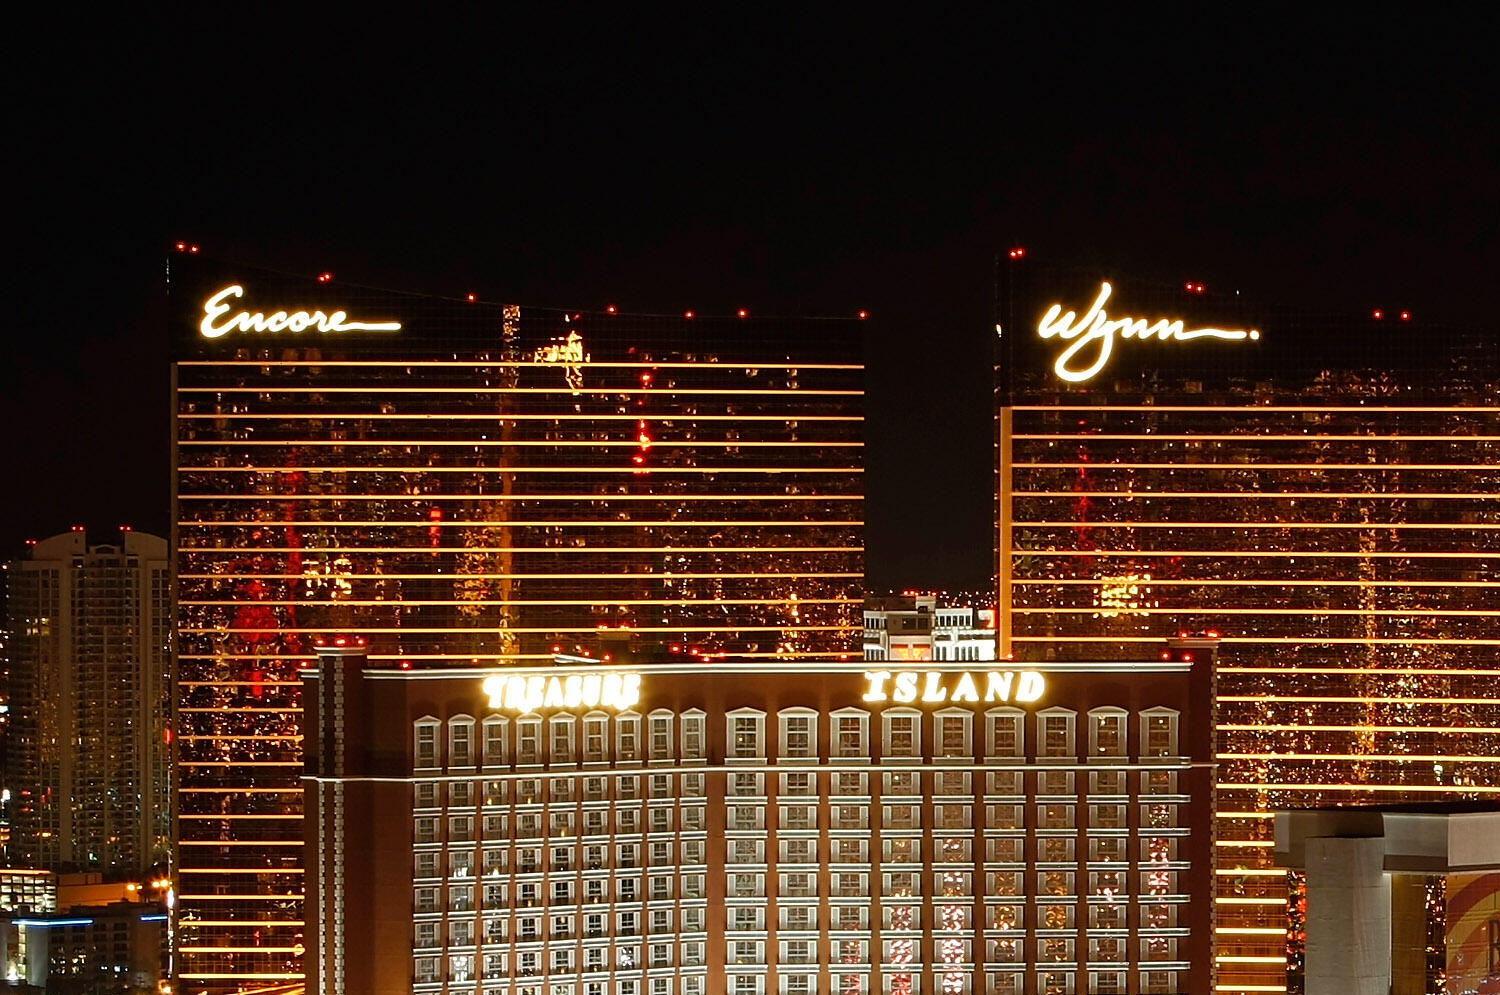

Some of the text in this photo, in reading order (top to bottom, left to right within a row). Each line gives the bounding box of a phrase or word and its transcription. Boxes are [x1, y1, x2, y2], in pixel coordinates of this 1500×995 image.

[200, 285, 402, 338] Encore
[483, 670, 1047, 713] TREASURE ISLAND
